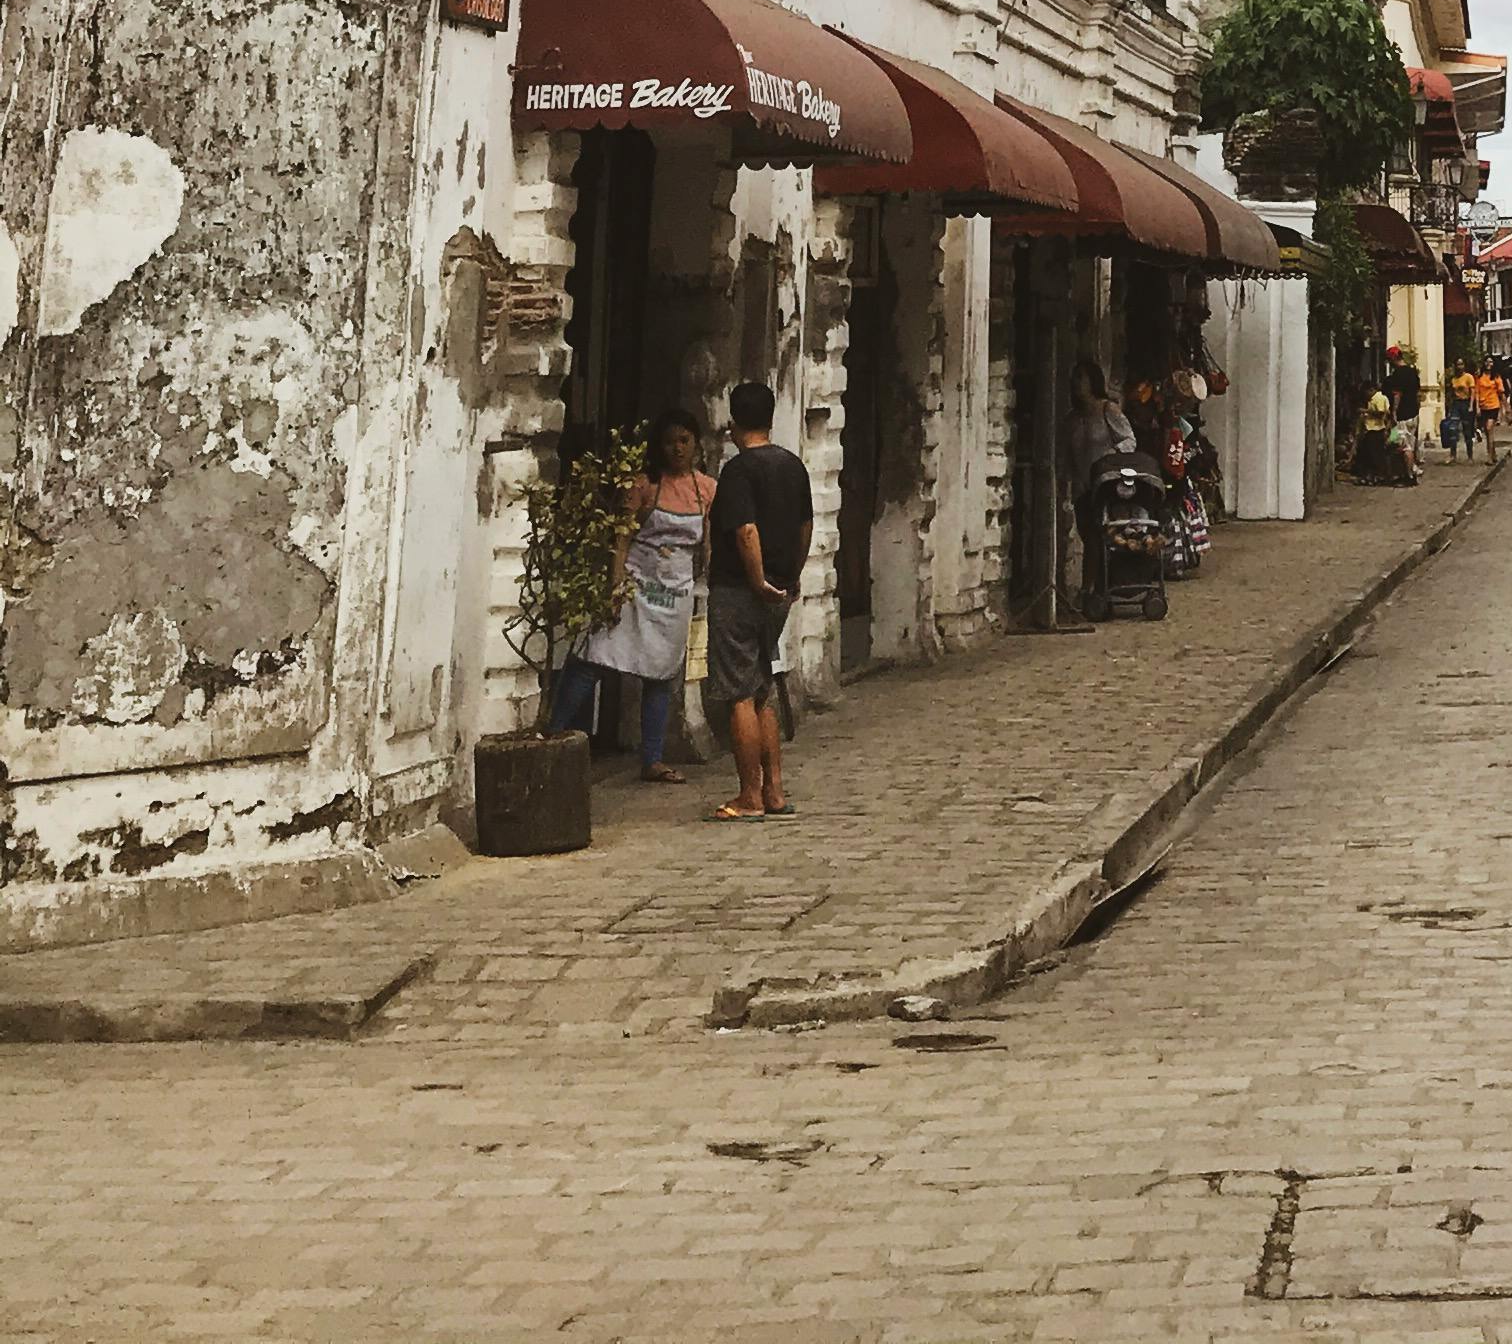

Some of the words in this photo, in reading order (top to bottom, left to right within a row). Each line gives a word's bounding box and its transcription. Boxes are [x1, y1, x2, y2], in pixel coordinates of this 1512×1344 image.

[526, 83, 624, 110] HERITAGE
[629, 78, 735, 118] Bakery
[746, 66, 798, 114] HERITAGE
[796, 80, 841, 138] Bakery
